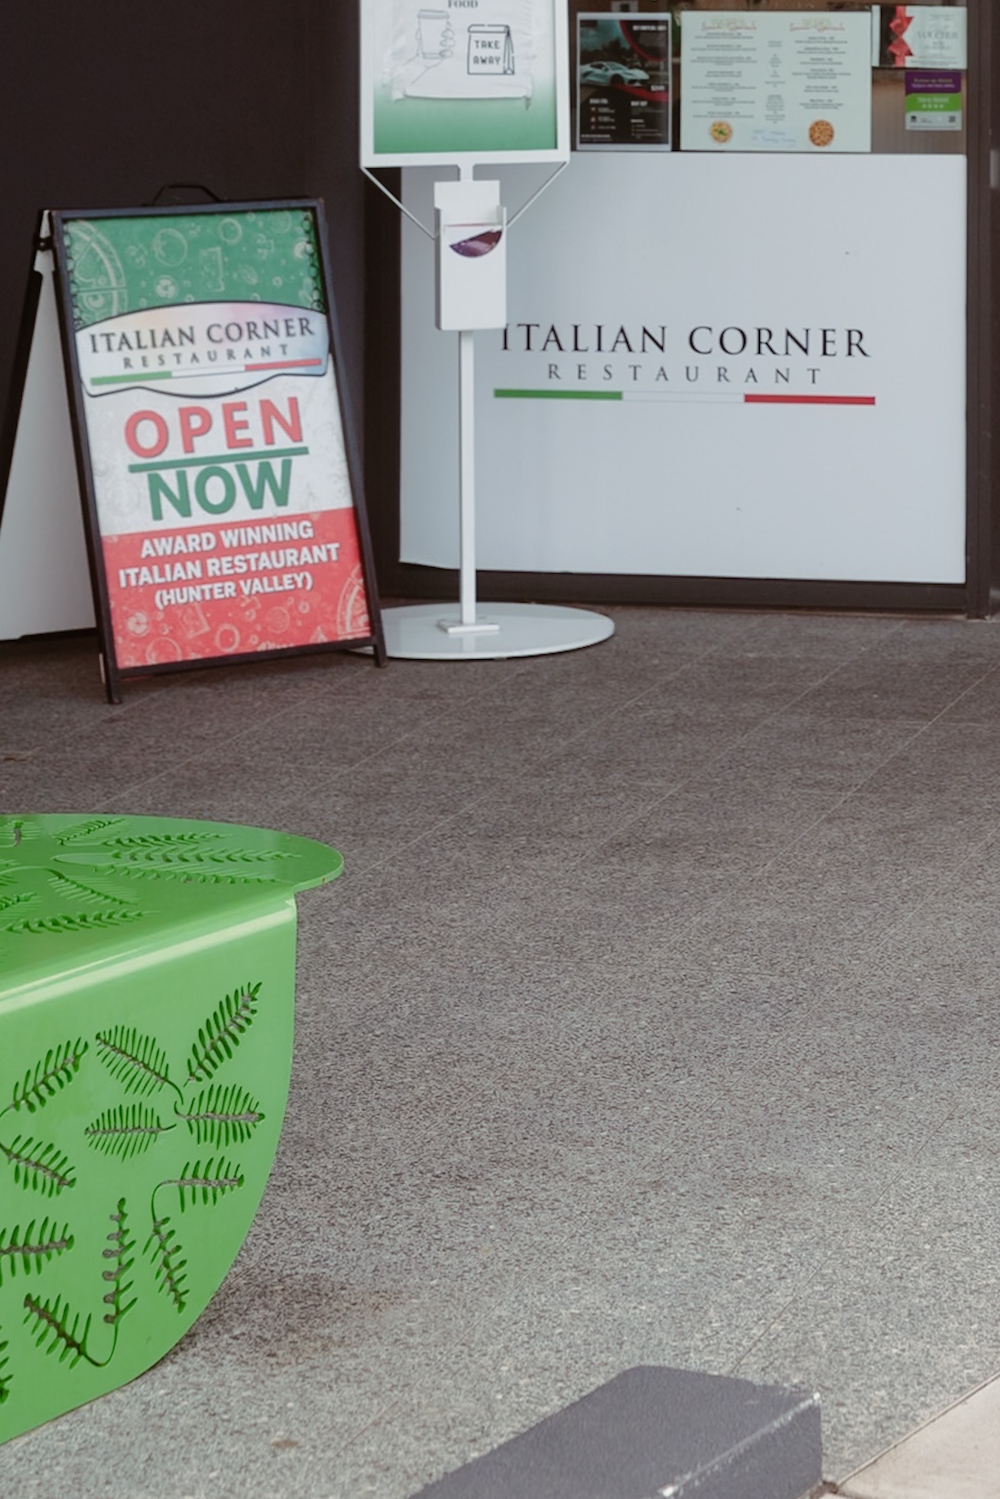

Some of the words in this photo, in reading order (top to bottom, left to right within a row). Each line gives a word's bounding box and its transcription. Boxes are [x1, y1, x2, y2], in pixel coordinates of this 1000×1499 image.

[447, 0, 479, 9] FOOD
[473, 55, 501, 66] AWAY
[474, 39, 501, 50] TAKE
[89, 325, 196, 354] ITALIAN
[206, 317, 316, 344] CORNER
[501, 323, 668, 354] ITALIAN
[688, 325, 872, 358] CORNER
[123, 343, 290, 370] RESTAURANT
[547, 363, 822, 385] RESTAURANT
[124, 396, 304, 459] OPEN
[147, 458, 293, 521] NOW
[140, 532, 217, 559] AWARD
[220, 520, 315, 549] WINNING
[118, 560, 203, 588] ITALIAN
[206, 542, 341, 577] RESTAURANT
[155, 580, 237, 610] (HUNTER
[240, 571, 314, 595] VALLEY)
